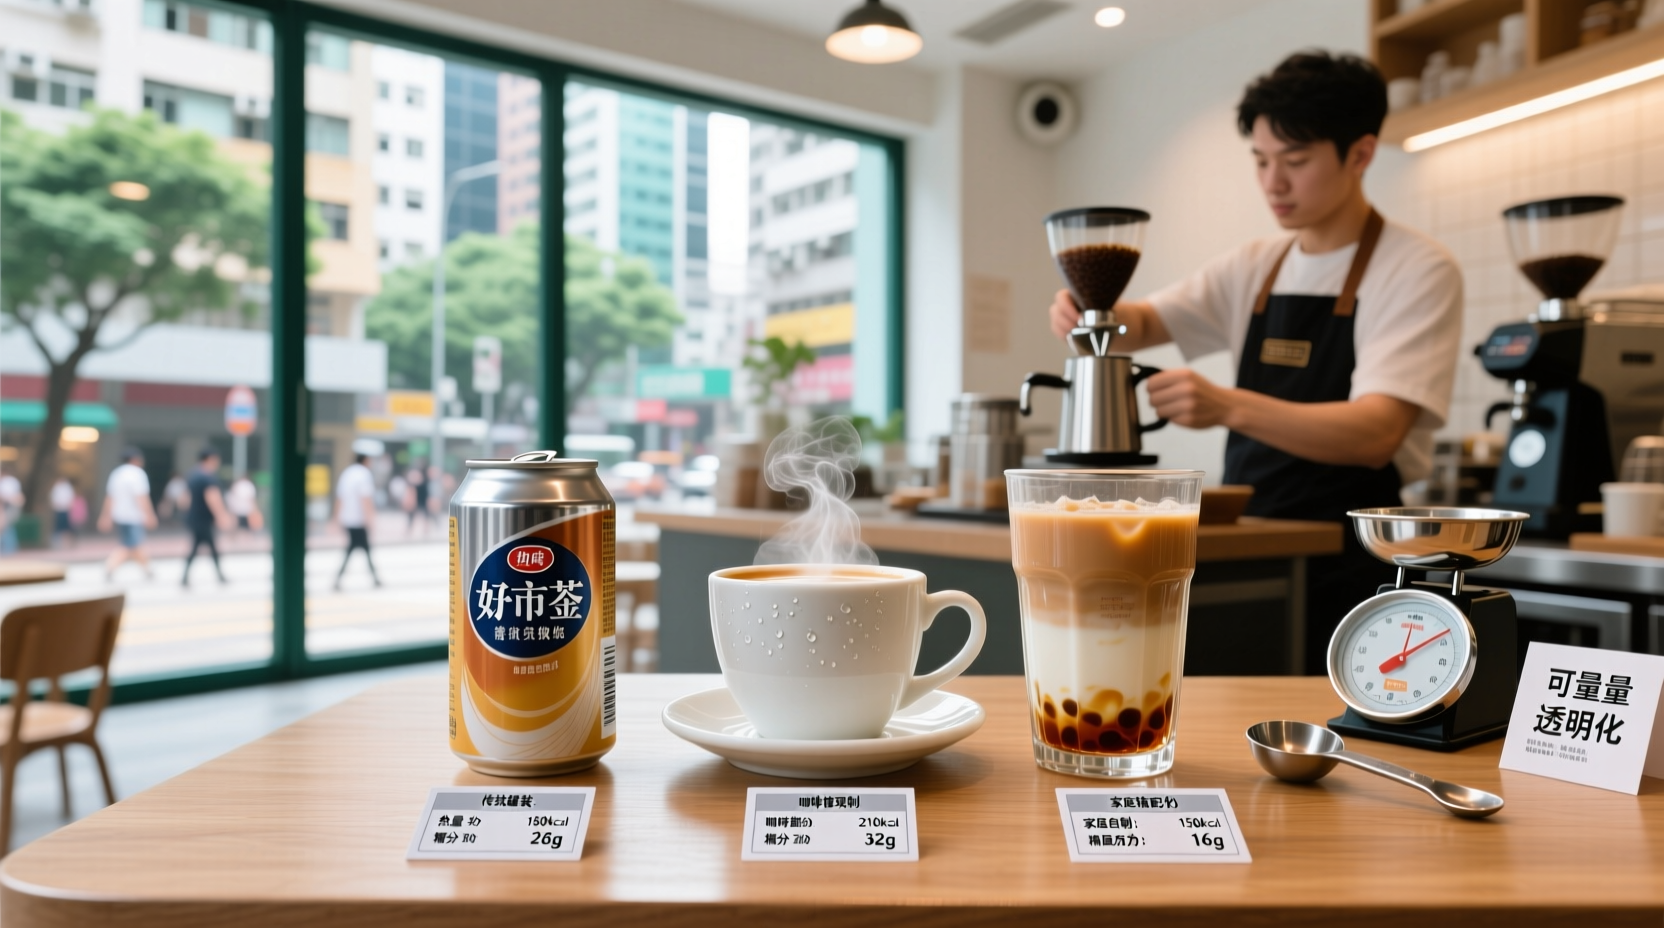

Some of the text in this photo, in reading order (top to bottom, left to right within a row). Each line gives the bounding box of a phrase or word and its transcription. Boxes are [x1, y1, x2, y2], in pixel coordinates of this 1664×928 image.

[1548, 667, 1634, 706] 可量量
[1532, 703, 1625, 746] 透明化
[530, 831, 563, 849] 26g
[864, 832, 896, 850] 32g
[1191, 832, 1225, 851] 16g
